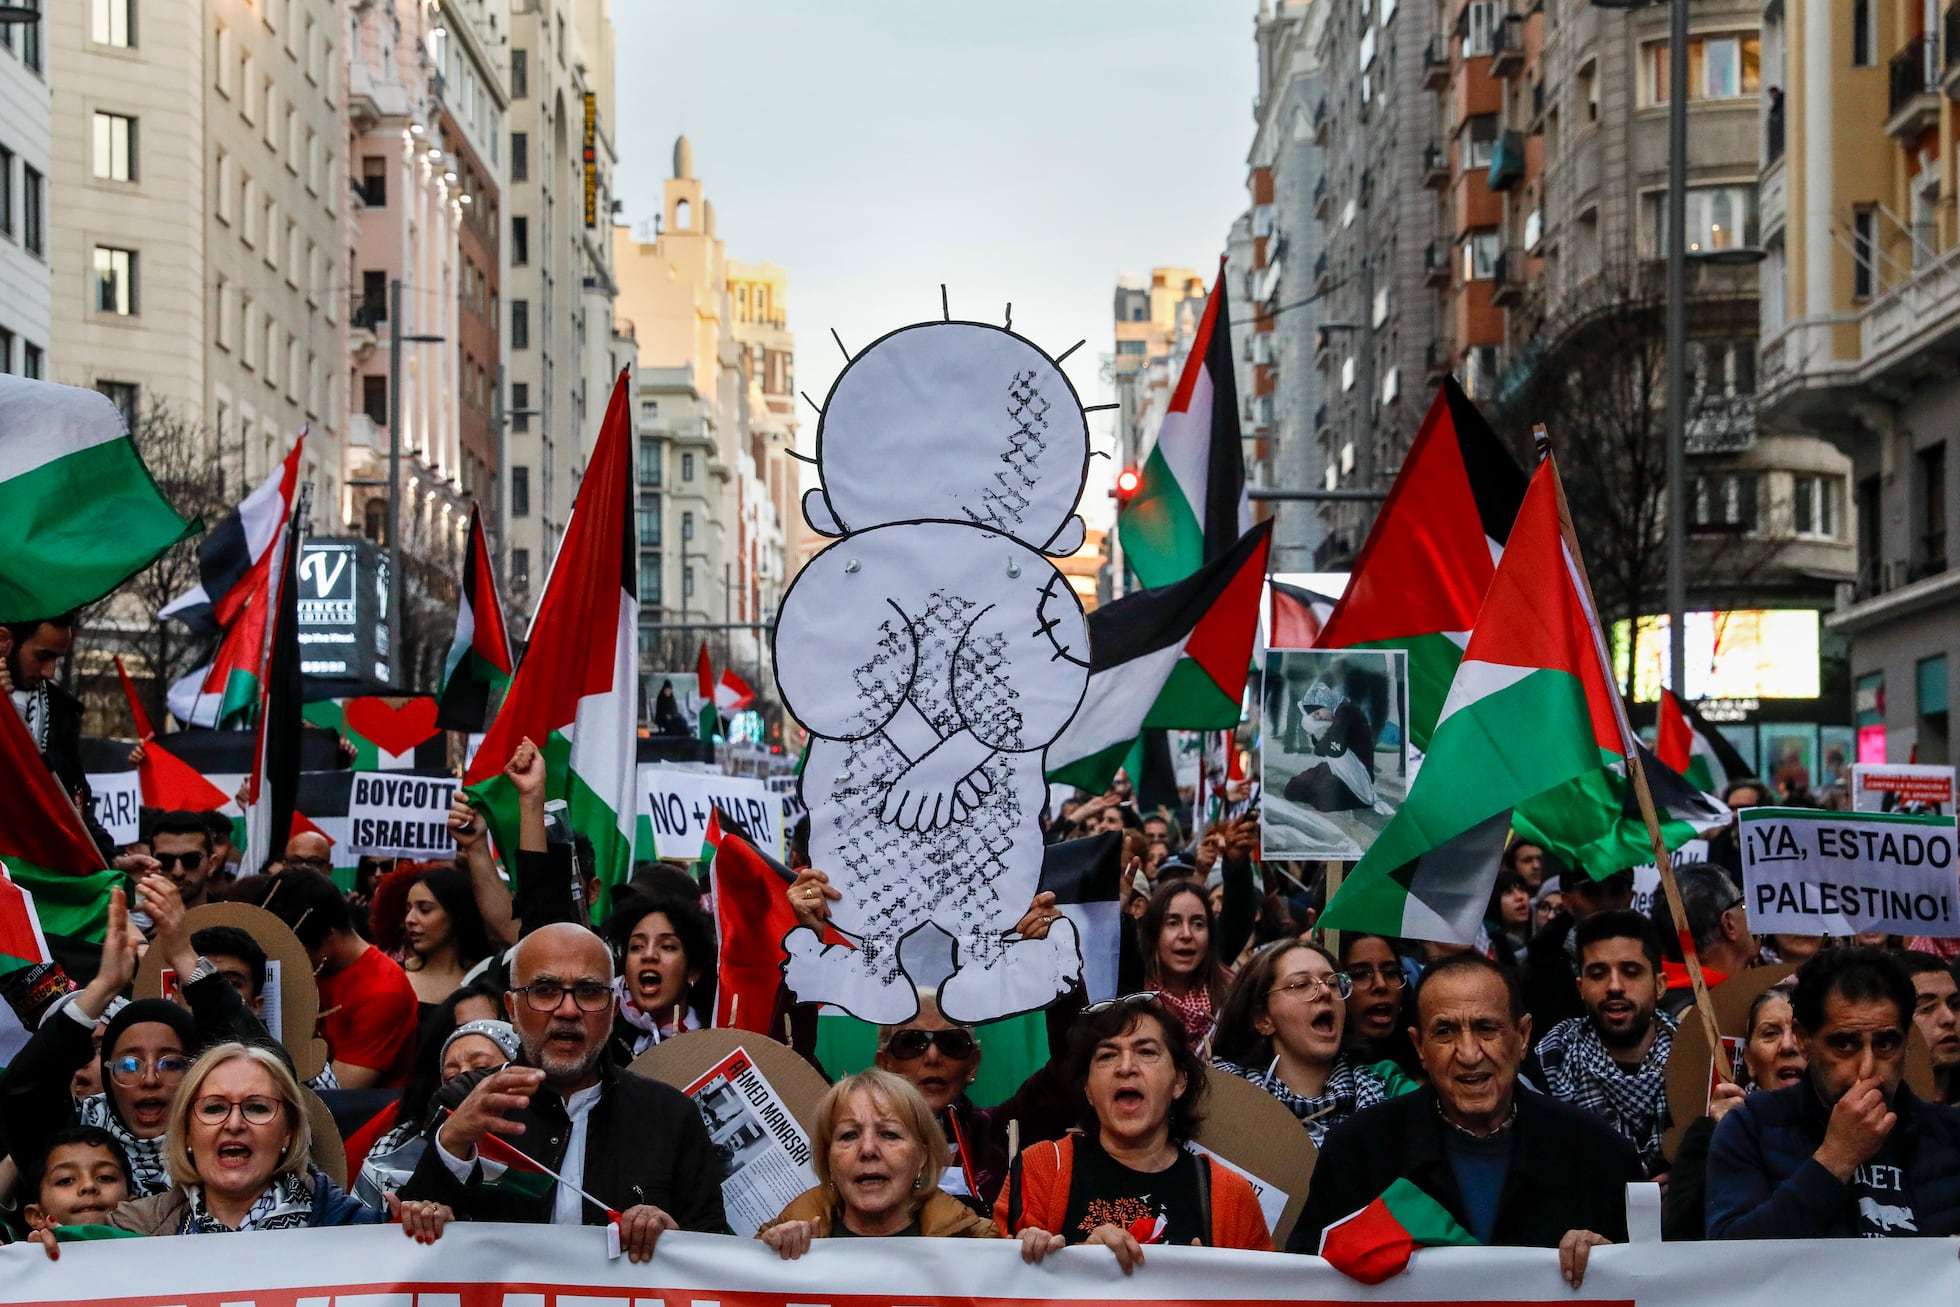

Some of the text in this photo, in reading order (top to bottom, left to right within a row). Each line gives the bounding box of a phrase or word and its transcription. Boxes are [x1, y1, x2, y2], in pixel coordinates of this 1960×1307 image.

[355, 778, 457, 810] BOYCOTT
[649, 792, 687, 836] NO
[352, 818, 452, 850] ISRAEL!!!
[1747, 825, 1951, 869] ¡YA, ESTADO
[1756, 881, 1950, 922] PALESTINO!
[728, 1059, 769, 1107] AHMED
[760, 1102, 811, 1167] MANASRA
